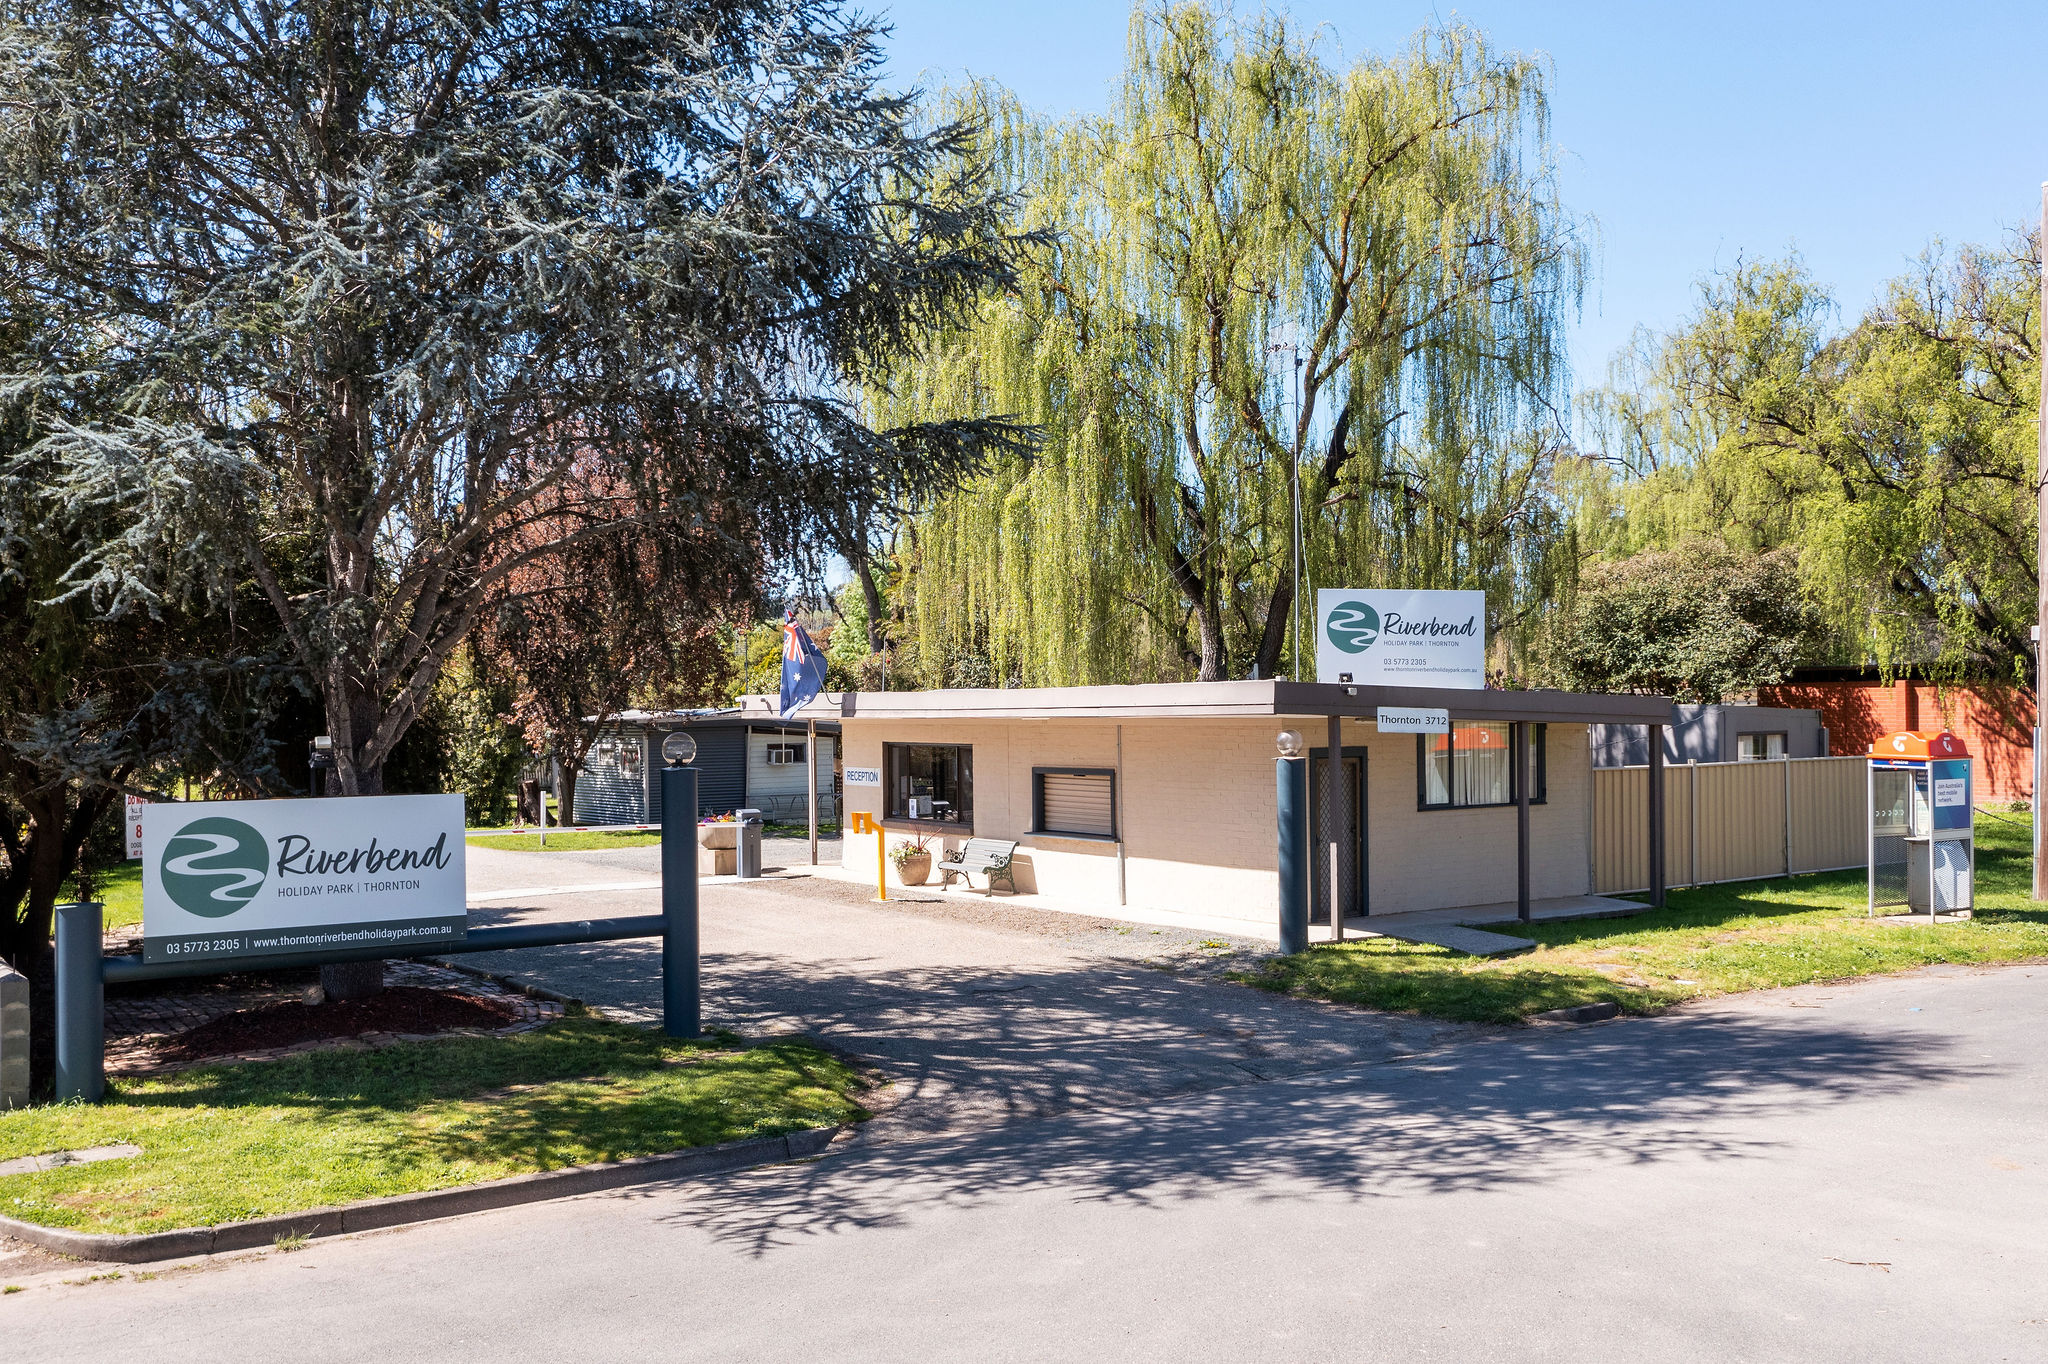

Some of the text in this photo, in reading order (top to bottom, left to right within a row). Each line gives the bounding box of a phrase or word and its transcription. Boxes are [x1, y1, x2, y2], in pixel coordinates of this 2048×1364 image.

[1383, 612, 1477, 637] Riverbend
[1410, 658, 1427, 666] 2305
[1380, 714, 1447, 725] Thornton 3712
[847, 770, 878, 782] RECEPTION
[136, 824, 142, 838] 8
[277, 832, 452, 878] Riverbend
[277, 879, 420, 898] HOLIDAY PARK THORNTON
[166, 926, 452, 954] 03 5773 2305 www.thorntonriverbendholidaypark.com.au
